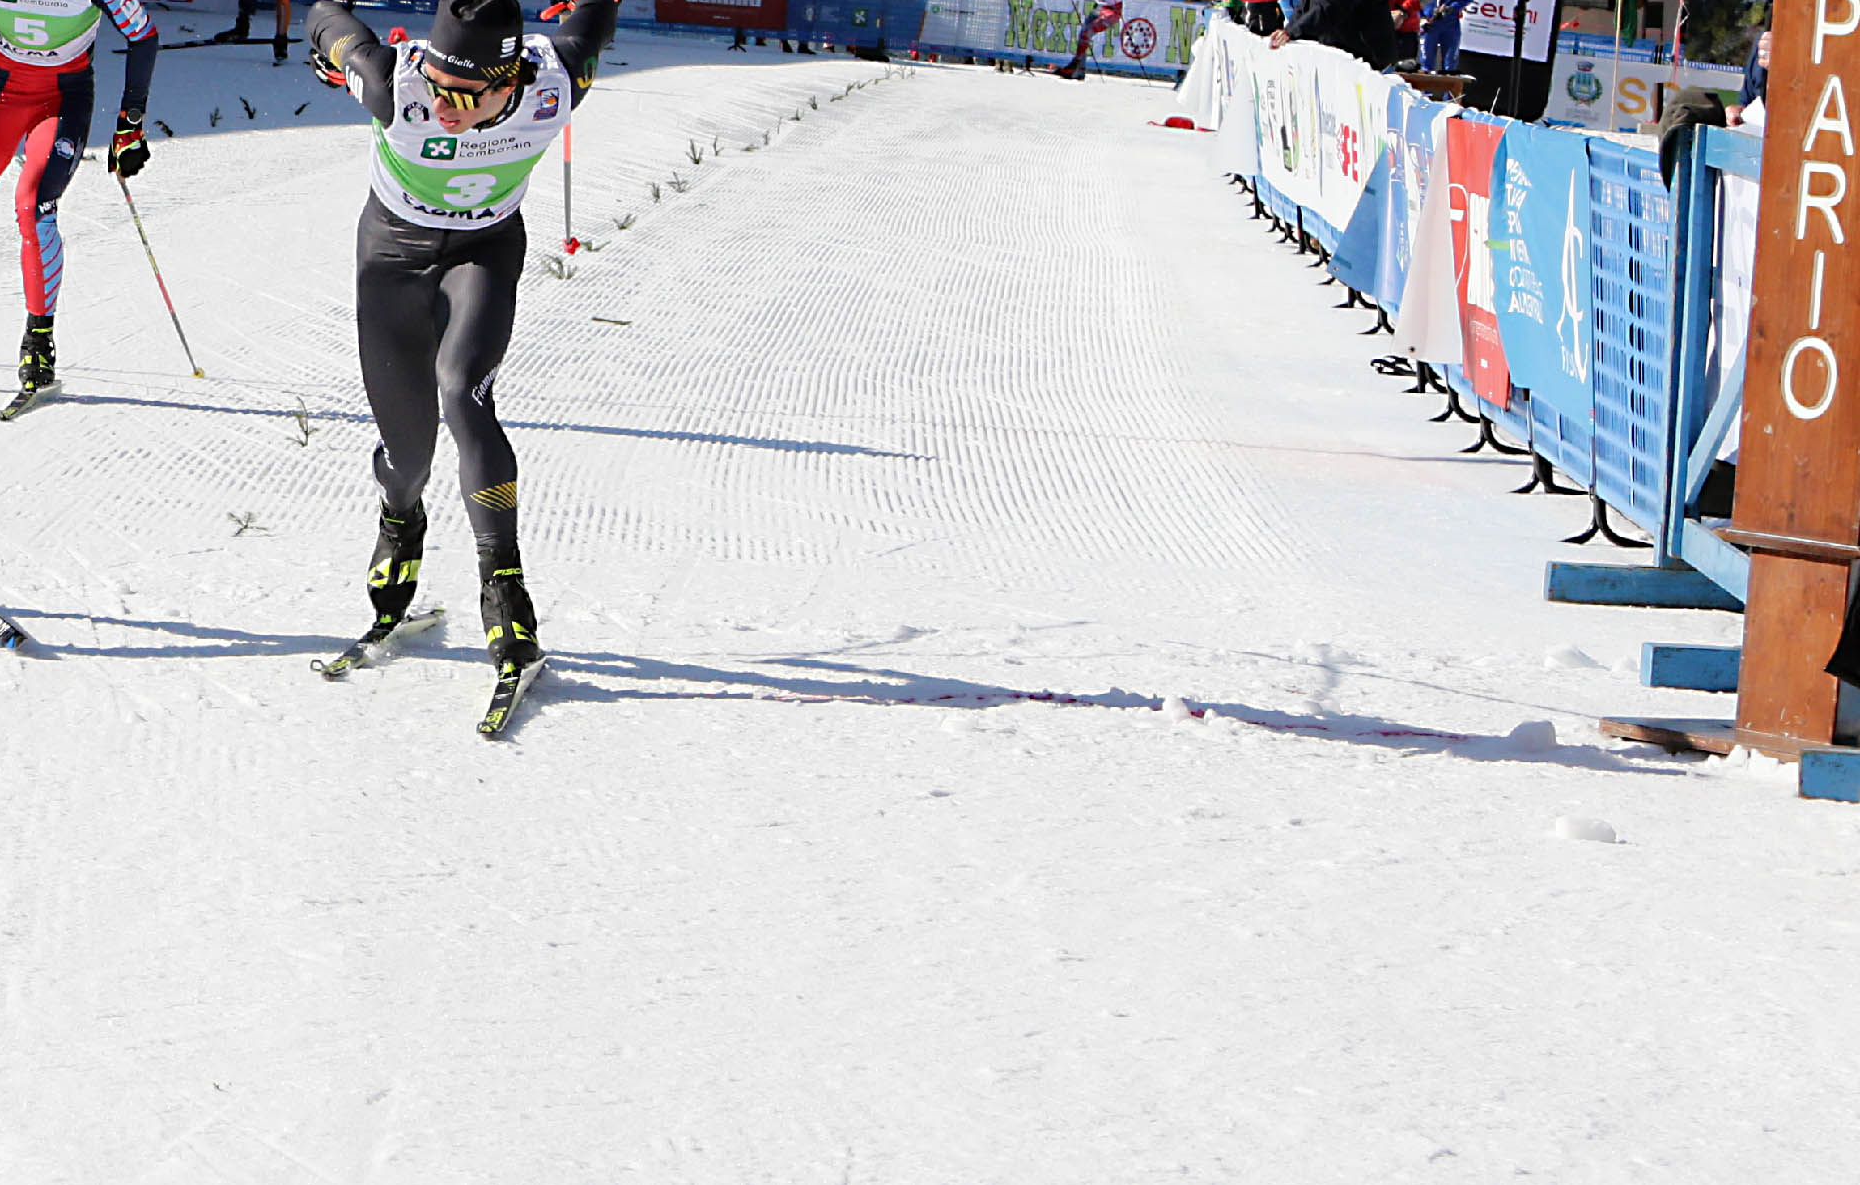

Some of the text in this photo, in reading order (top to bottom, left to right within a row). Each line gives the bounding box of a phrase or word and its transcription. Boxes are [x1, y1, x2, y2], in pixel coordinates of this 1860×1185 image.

[13, 17, 49, 46] 5
[460, 136, 516, 150] Regione
[443, 173, 497, 207] 3
